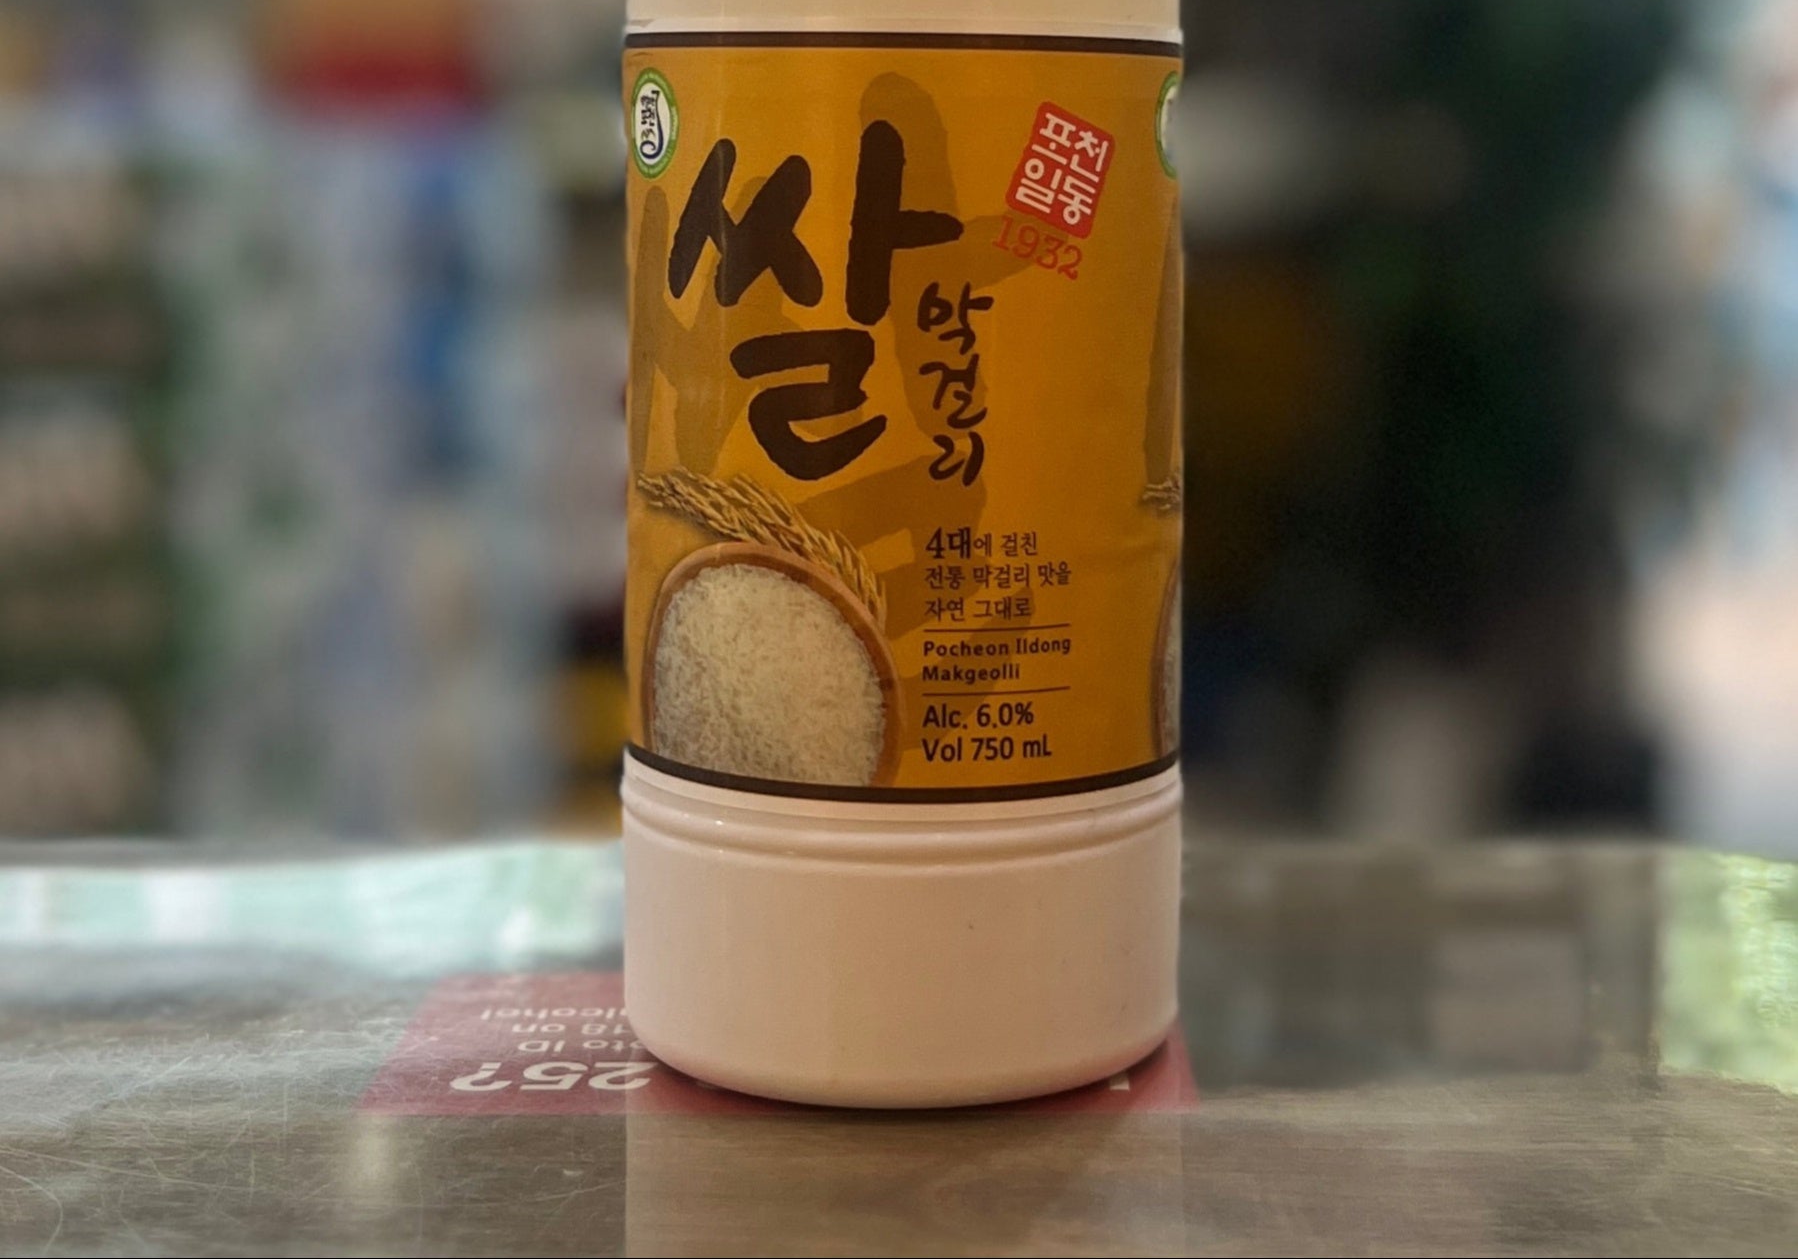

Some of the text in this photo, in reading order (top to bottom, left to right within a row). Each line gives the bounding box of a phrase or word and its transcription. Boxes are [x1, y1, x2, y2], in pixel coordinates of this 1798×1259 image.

[1032, 112, 1108, 183] 포천
[1015, 158, 1096, 225] 일동
[992, 217, 1083, 281] 1932
[668, 120, 964, 481] 쌀
[917, 282, 993, 486] 막걸리
[925, 527, 1038, 560] 4대에 걸친
[924, 561, 1072, 590] 전통 막걸리 맛을
[924, 598, 1032, 622] 자연 그대로
[923, 638, 1071, 657] Pocheon Ildong
[922, 663, 1020, 685] Makgeolli
[922, 701, 1034, 729] Alc. 6.0%
[922, 734, 1052, 762] Vol 750 mL
[512, 1024, 566, 1035] on
[517, 1040, 565, 1054] ID
[449, 1061, 658, 1092] 25?
